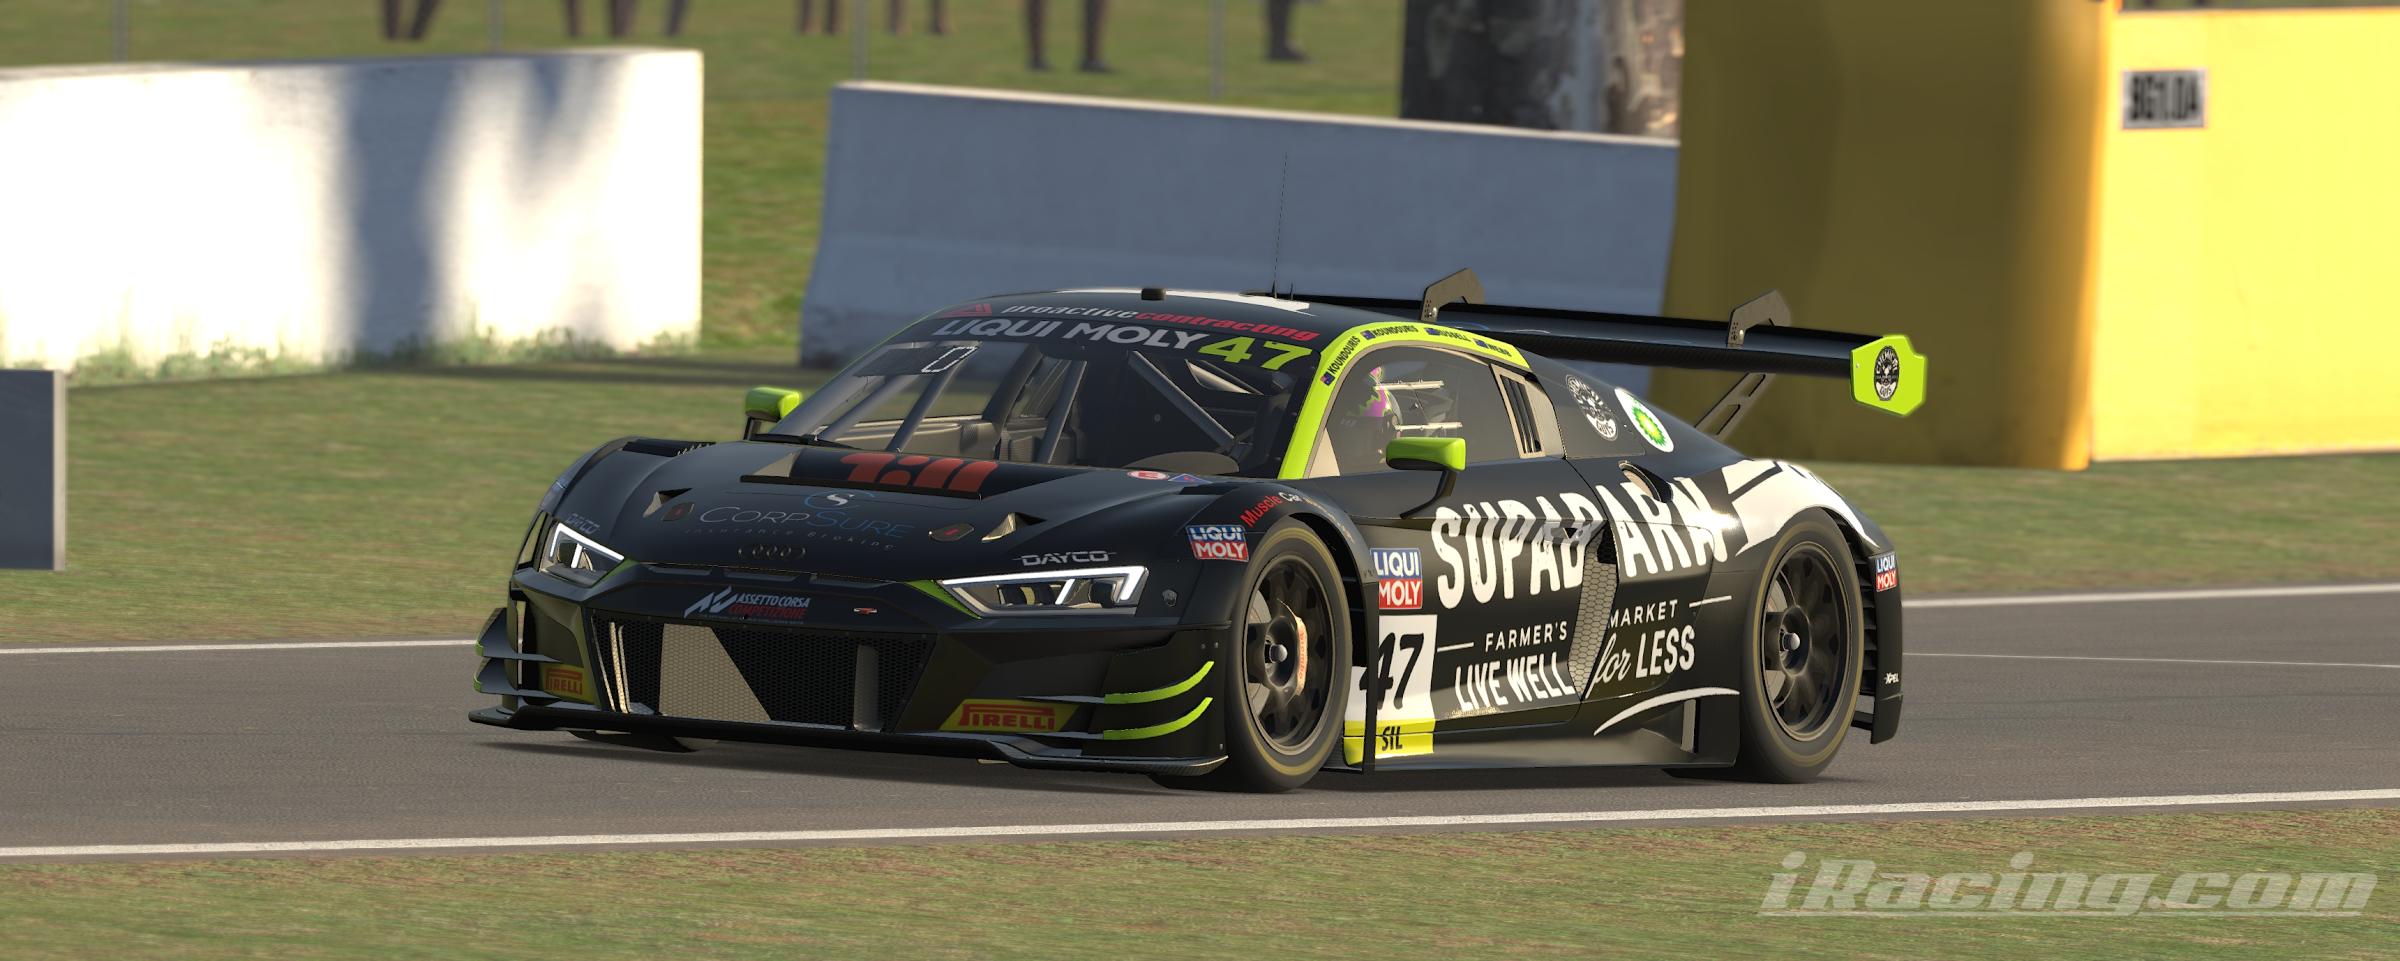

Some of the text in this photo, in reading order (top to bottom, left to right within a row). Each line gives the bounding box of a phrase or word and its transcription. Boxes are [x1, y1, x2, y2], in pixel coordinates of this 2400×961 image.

[931, 318, 1313, 371] LIQUI MOLY 47
[1329, 335, 1361, 375] KOUNDOURIS
[1239, 493, 1281, 528] Muscle
[1189, 525, 1244, 542] LIQUI
[1020, 550, 1110, 567] DAYCO
[1196, 541, 1248, 560] MOLY
[1876, 554, 1896, 573] LIQUI
[1373, 551, 1420, 578] LIQUI
[1876, 570, 1897, 590] MOLY
[736, 592, 811, 608] ASSETTO CORSA
[1378, 581, 1422, 607] MOLY
[1484, 599, 1679, 652] FARMER'S MARKET
[1359, 631, 1425, 710] 47
[1454, 624, 1696, 712] LIVE WELL for LESS
[958, 703, 1056, 731] PIRELLI
[1381, 725, 1403, 751] SIL
